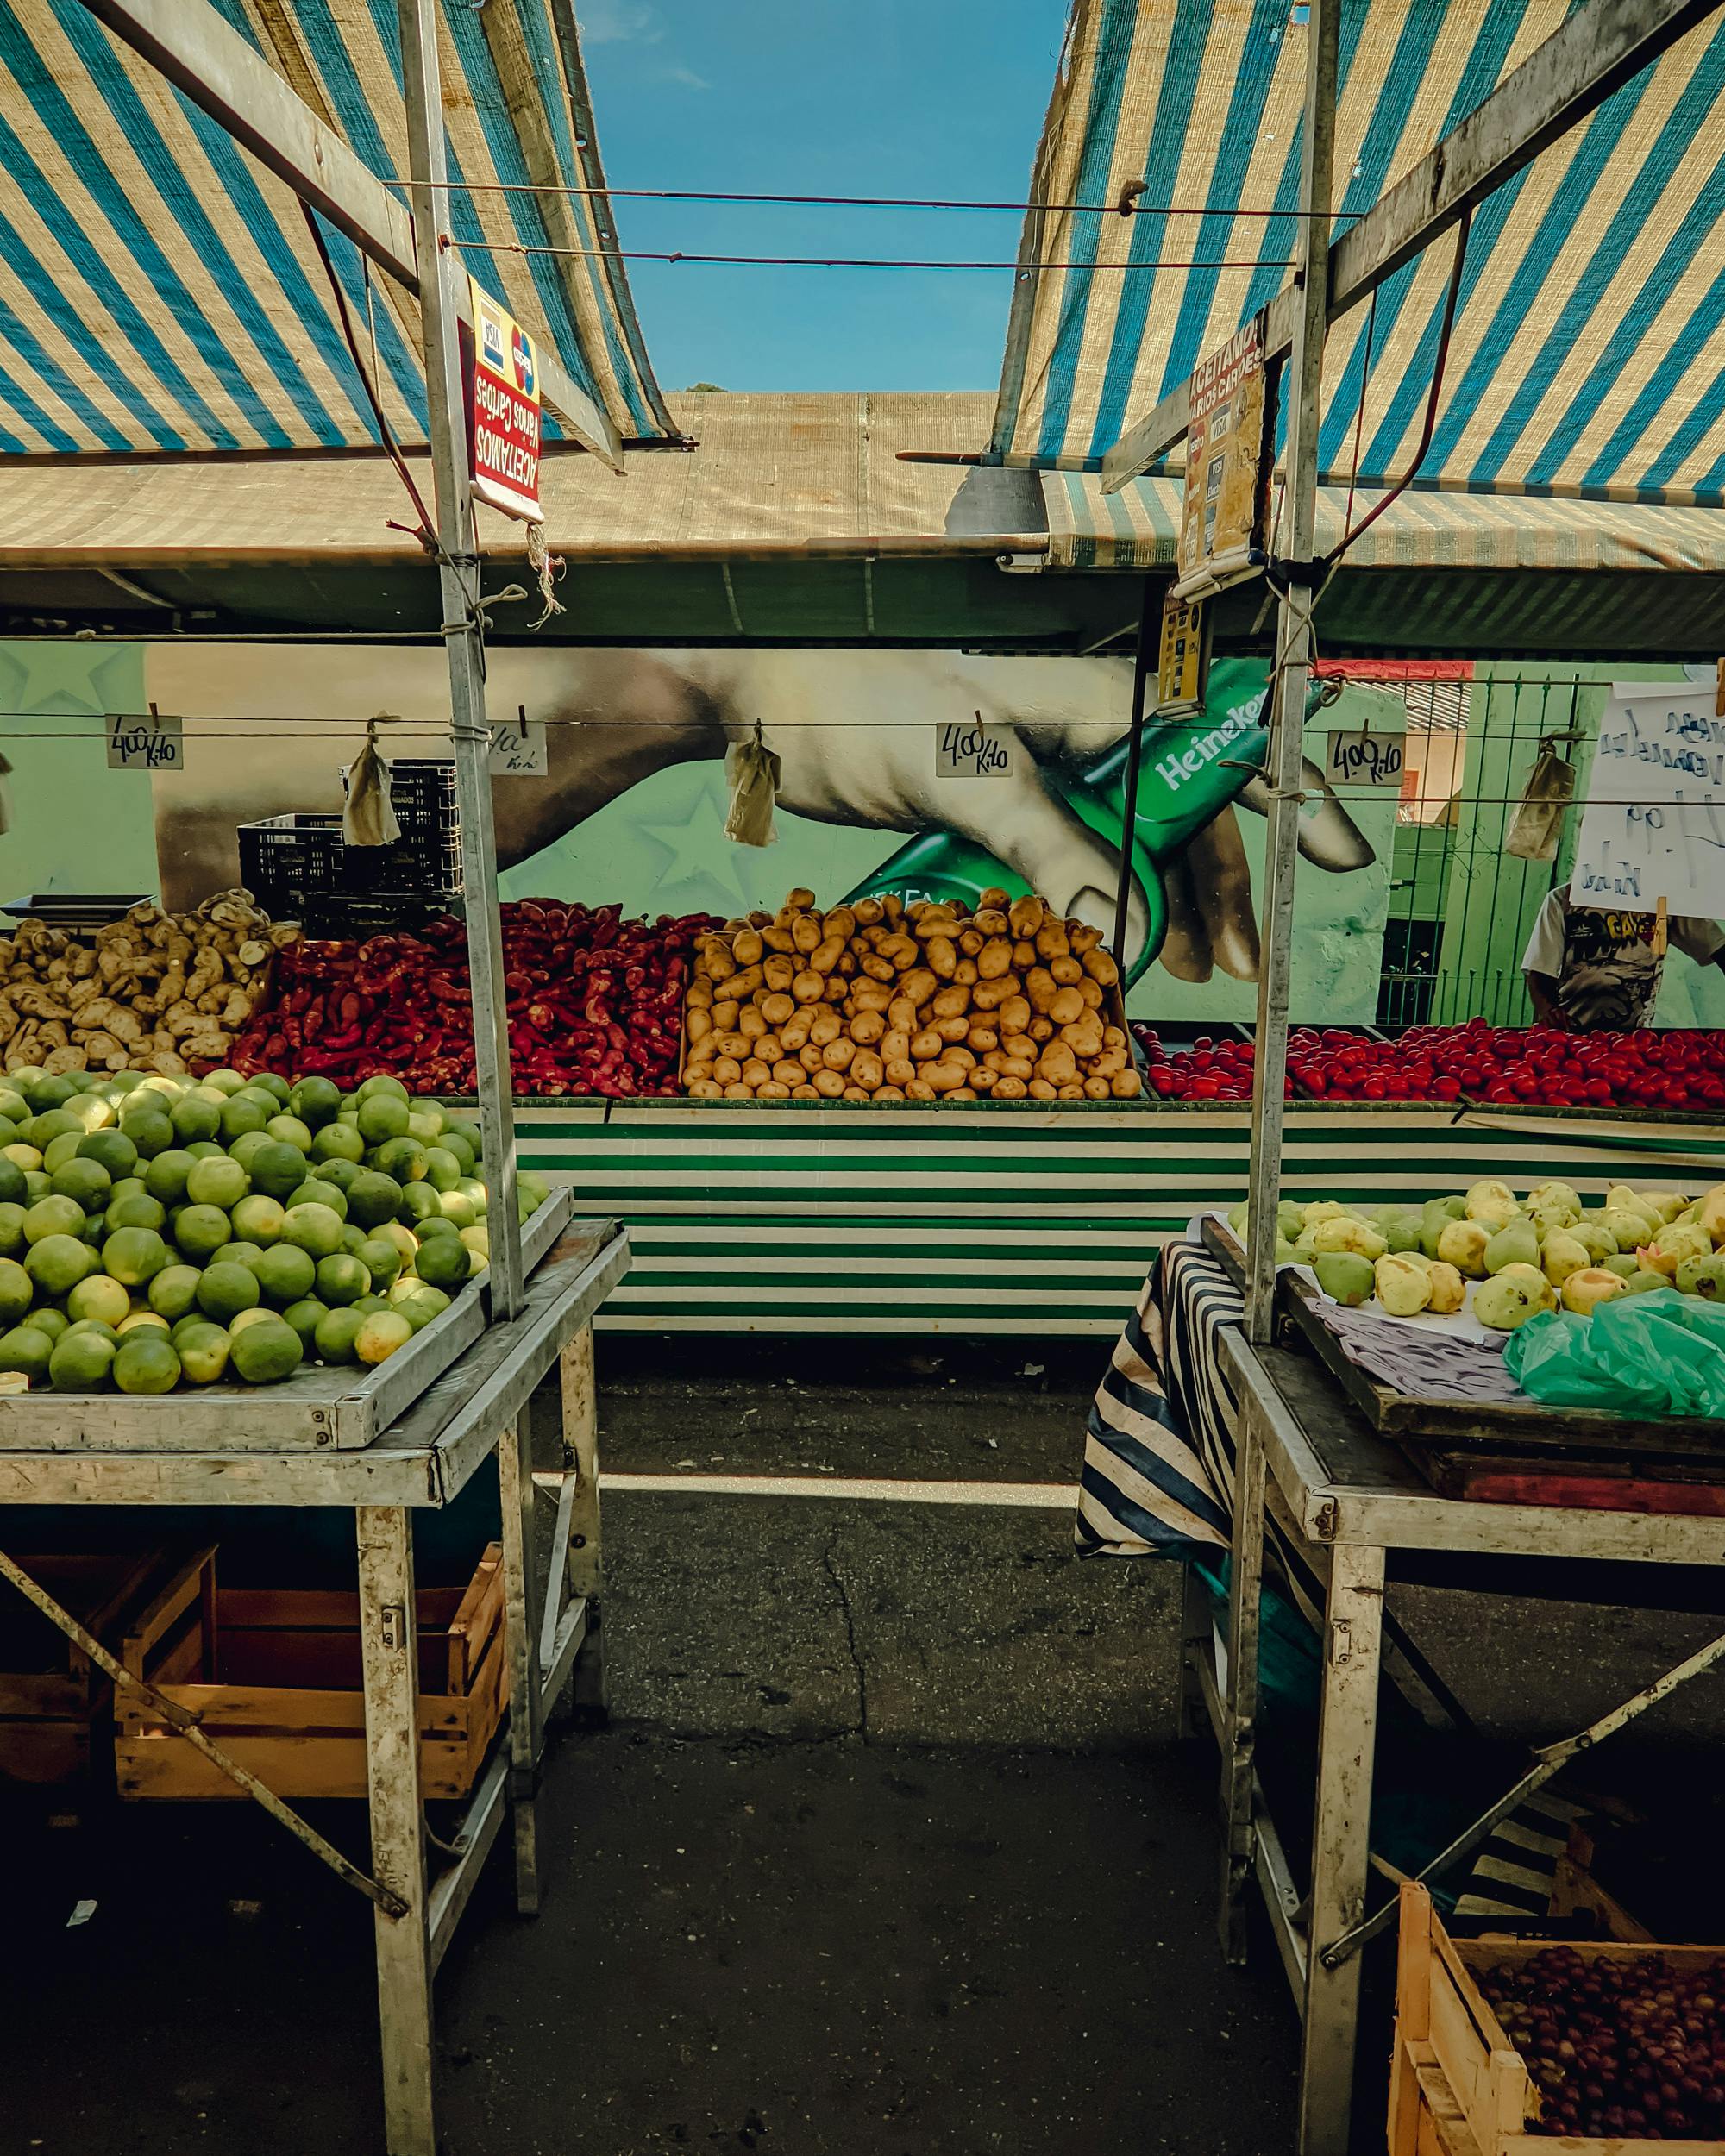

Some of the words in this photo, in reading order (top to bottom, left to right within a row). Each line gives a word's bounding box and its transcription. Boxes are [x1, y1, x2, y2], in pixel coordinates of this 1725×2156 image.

[484, 321, 500, 352] VISA
[475, 374, 511, 434] Cartões
[1213, 414, 1228, 441] VISA
[475, 423, 538, 490] ACEITAMOS
